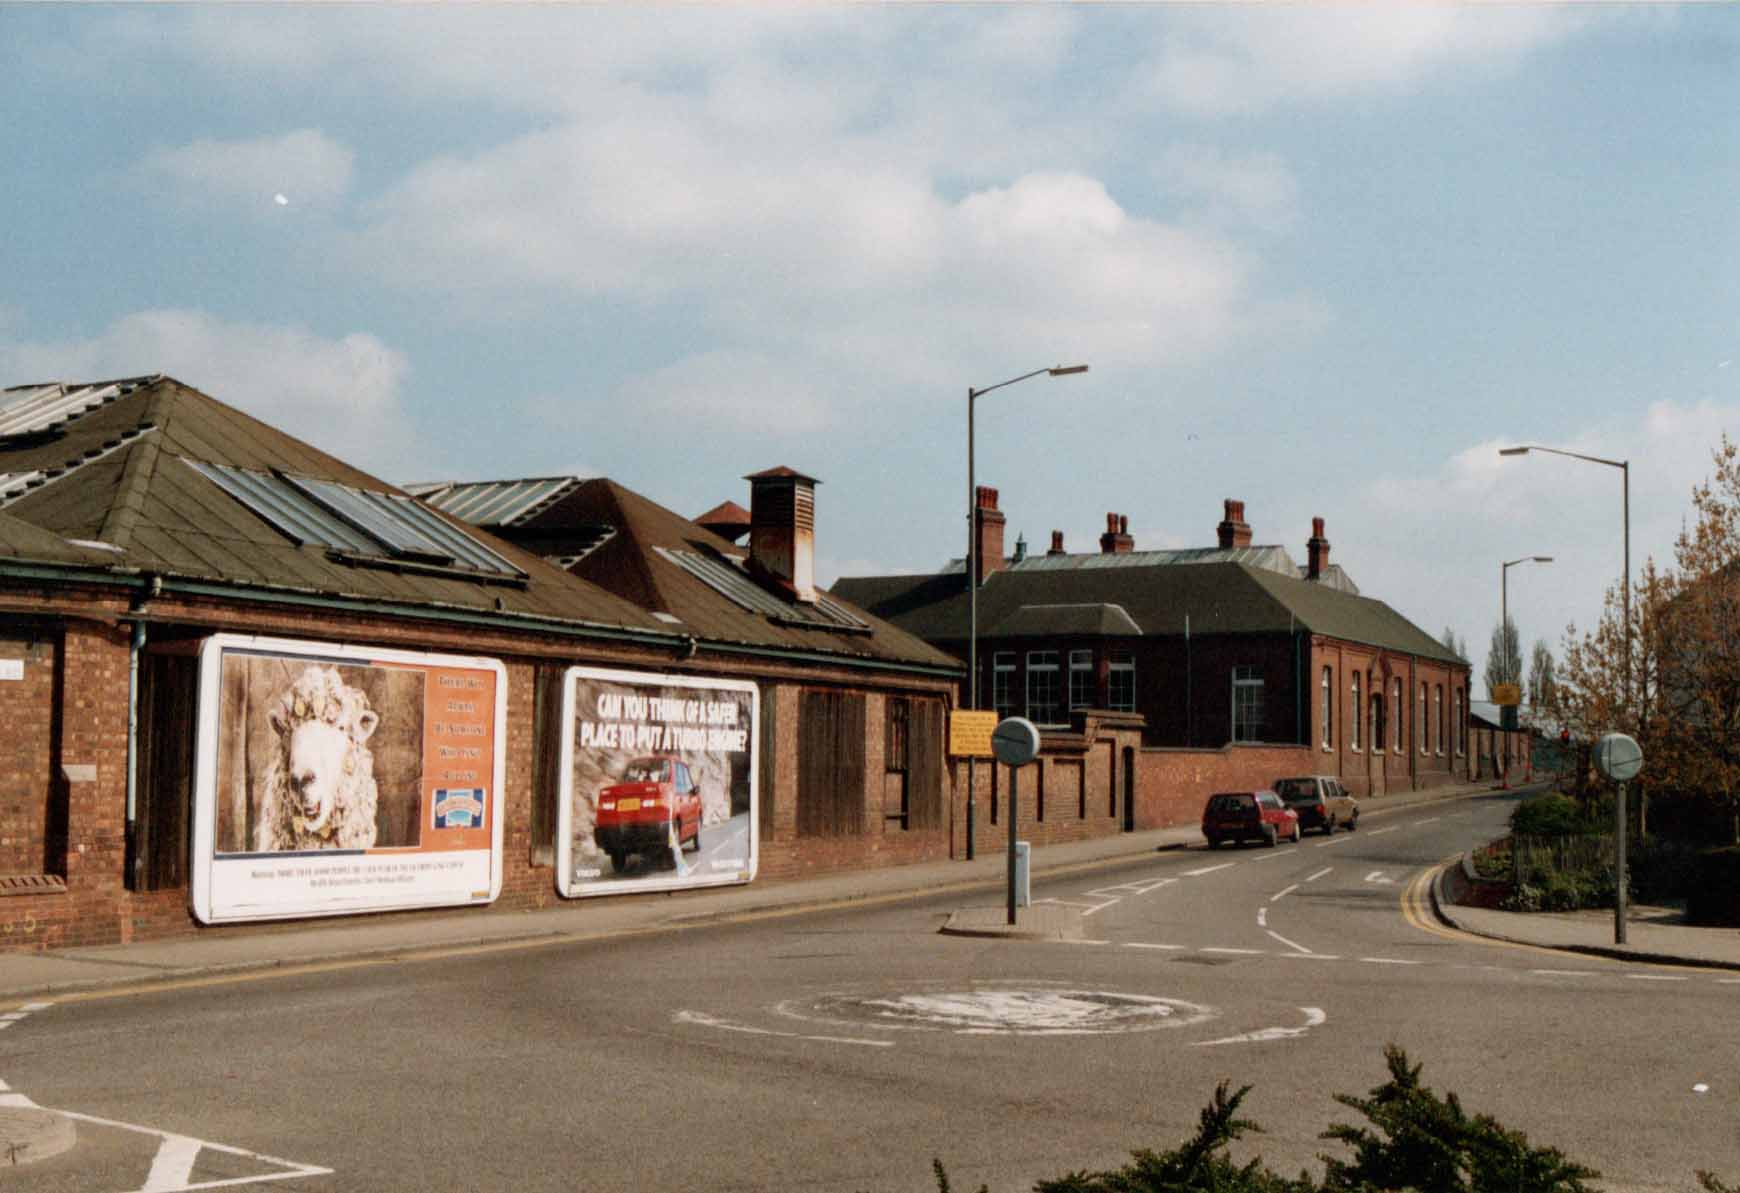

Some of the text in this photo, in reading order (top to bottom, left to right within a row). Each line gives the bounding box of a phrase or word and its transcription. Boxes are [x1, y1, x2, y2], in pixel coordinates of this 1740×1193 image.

[597, 694, 621, 719] CAN
[623, 695, 648, 720] YOU
[580, 721, 618, 748] PLACE
[619, 723, 635, 748] TO
[636, 724, 663, 749] PUT
[662, 725, 672, 750] A
